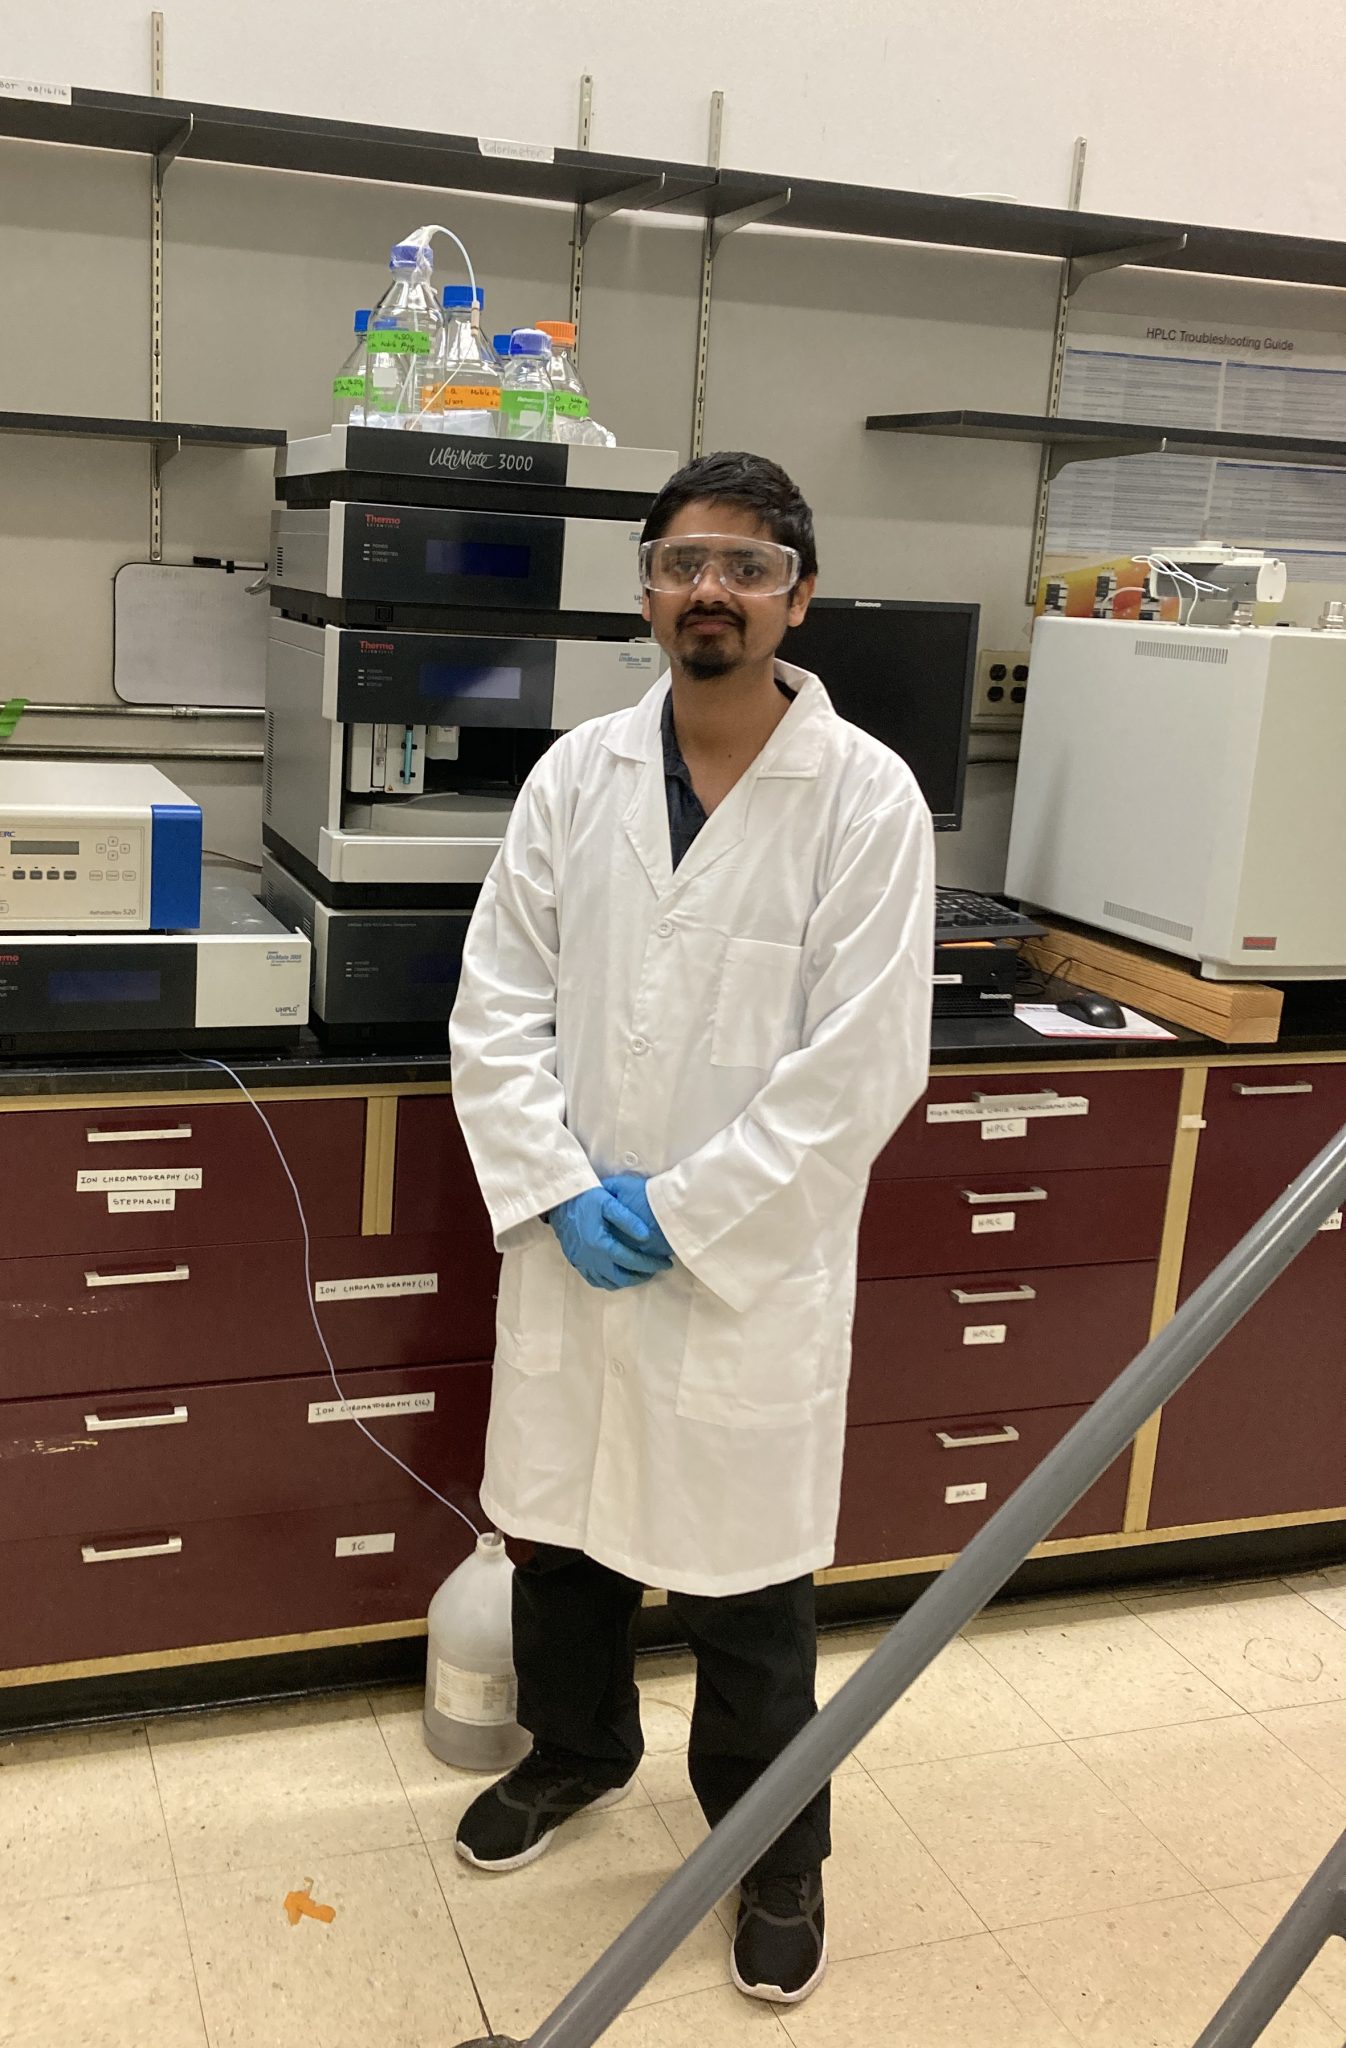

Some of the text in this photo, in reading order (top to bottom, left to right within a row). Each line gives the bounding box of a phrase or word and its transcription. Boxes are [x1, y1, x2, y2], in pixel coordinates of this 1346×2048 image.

[1146, 328, 1294, 351] HPLC Troubleshooting Guide
[429, 447, 534, 471] UltiMate 3000
[365, 514, 401, 524] Thermo
[359, 640, 395, 650] Thermo
[123, 908, 137, 916] 520
[986, 1123, 1015, 1135] HPLC
[81, 1176, 98, 1184] ION
[103, 1174, 181, 1184] CHROMATOGRAPHY
[112, 1198, 172, 1206] STEPHANIE
[320, 1286, 336, 1295] ION
[315, 1407, 335, 1416] ION
[351, 1540, 366, 1552] IC
